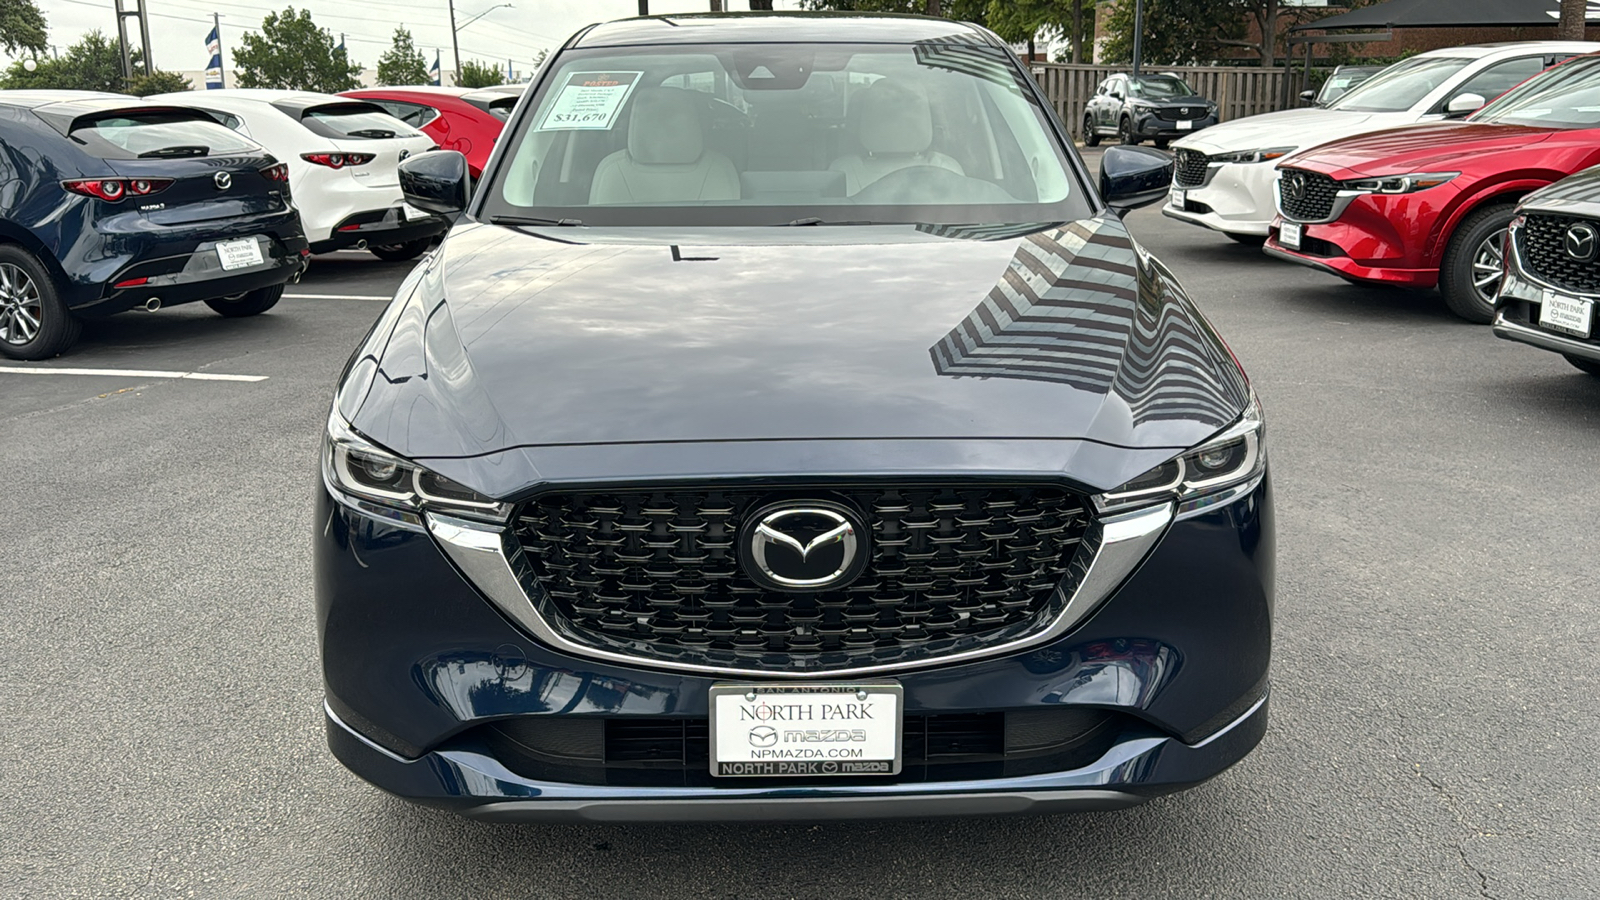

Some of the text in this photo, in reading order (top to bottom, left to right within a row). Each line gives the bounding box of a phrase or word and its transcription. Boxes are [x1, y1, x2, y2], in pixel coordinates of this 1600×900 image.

[554, 113, 607, 122] $31,670
[1549, 300, 1585, 315] NORTH PARK
[740, 703, 874, 721] NORTH PARK
[784, 729, 867, 743] mazda
[751, 748, 863, 759] NPMAZDA.COM
[722, 762, 889, 774] NORTH PARK mazda
